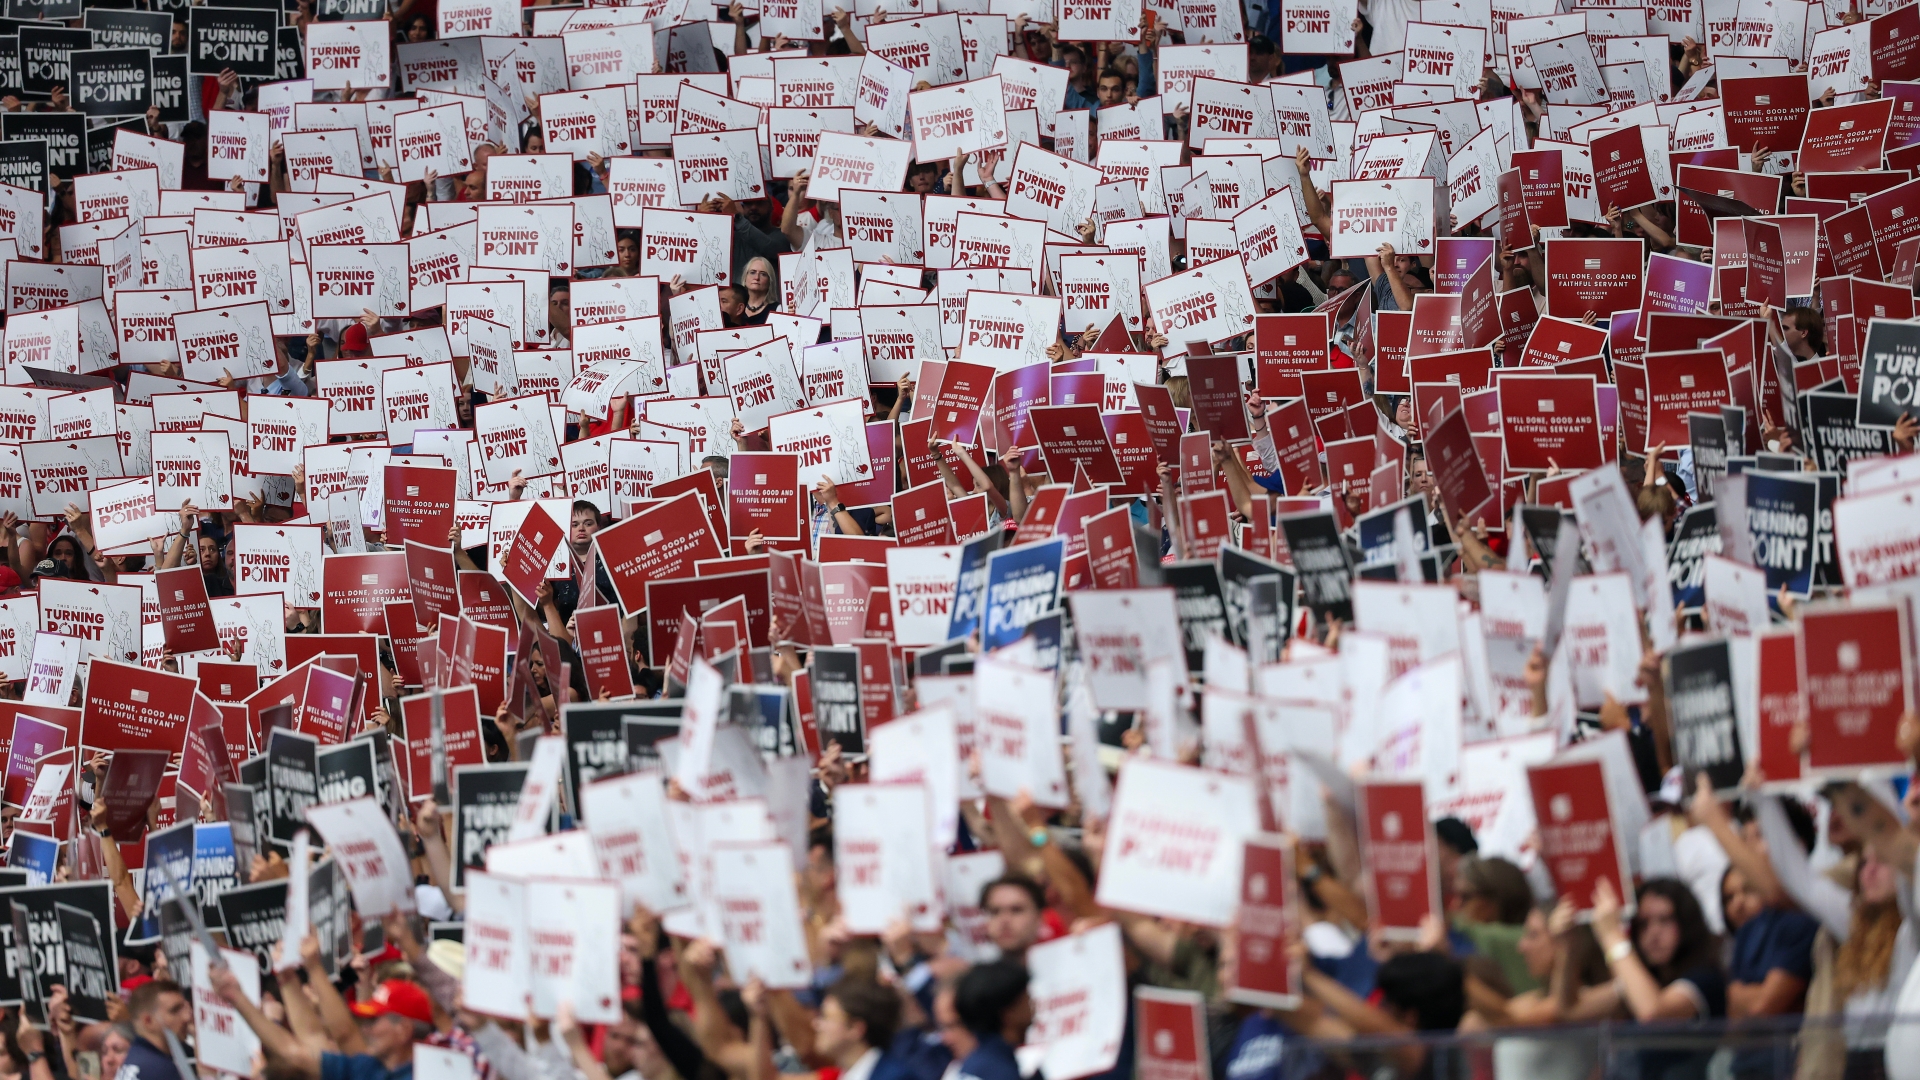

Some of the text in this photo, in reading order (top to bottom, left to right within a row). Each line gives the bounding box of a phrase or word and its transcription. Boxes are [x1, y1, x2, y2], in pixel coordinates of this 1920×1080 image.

[443, 8, 492, 22] TURNING
[763, 5, 797, 18] POINT
[1064, 8, 1111, 20] POINT
[1181, 5, 1216, 15] TURNING
[1286, 10, 1330, 19] TURNING
[1648, 8, 1692, 22] POINT
[444, 18, 492, 33] POINT
[1183, 15, 1216, 28] POINT
[1287, 20, 1330, 33] POINT
[1738, 22, 1773, 32] TURNING
[198, 28, 268, 43] TURNING
[1737, 33, 1772, 47] POINT
[200, 42, 268, 62] POINT
[310, 46, 360, 56] TURNING
[569, 50, 622, 63] TURNING
[1408, 48, 1454, 61] TURNING
[1813, 49, 1850, 65] TURNING
[312, 56, 360, 69] POINT
[404, 59, 458, 72] TURNING
[571, 60, 622, 77] POINT
[1409, 61, 1453, 76] POINT
[1811, 60, 1850, 80] POINT
[77, 69, 145, 84] TURNING
[407, 68, 458, 84] POINT
[1540, 63, 1574, 79] TURNING
[780, 82, 834, 92] TURNING
[862, 75, 889, 98] TURNING
[1544, 74, 1578, 92] POINT
[80, 84, 145, 102] POINT
[782, 93, 834, 107] POINT
[860, 89, 887, 110] POINT
[917, 108, 974, 126] TURNING
[1197, 103, 1253, 120] TURNING
[1277, 110, 1309, 121] TURNING
[546, 115, 596, 128] TURNING
[1200, 115, 1252, 134] POINT
[1280, 121, 1311, 137] POINT
[549, 126, 596, 142] POINT
[921, 119, 974, 140] POINT
[211, 135, 246, 146] TURNING
[399, 133, 440, 147] TURNING
[212, 146, 246, 160] POINT
[402, 143, 442, 162] POINT
[290, 156, 333, 167] TURNING
[679, 158, 728, 168] TURNING
[820, 156, 874, 171] TURNING
[1365, 158, 1403, 167] TURNING
[682, 168, 729, 183] POINT
[818, 167, 873, 184] POINT
[1018, 169, 1066, 195] TURNING
[491, 180, 541, 189] TURNING
[613, 182, 666, 192] TURNING
[80, 196, 129, 210] TURNING
[614, 192, 665, 207] POINT
[1015, 182, 1063, 210] POINT
[1338, 207, 1397, 218] TURNING
[845, 216, 893, 227] TURNING
[1339, 218, 1397, 234] POINT
[482, 231, 538, 241] TURNING
[646, 235, 698, 248] TURNING
[848, 227, 894, 242] POINT
[1240, 225, 1276, 251] TURNING
[484, 242, 538, 255] POINT
[647, 247, 697, 263] POINT
[960, 240, 1010, 255] TURNING
[1243, 236, 1279, 266] POINT
[199, 270, 257, 284] TURNING
[317, 271, 374, 280] TURNING
[12, 286, 68, 297] TURNING
[202, 281, 257, 298] POINT
[319, 282, 374, 296] POINT
[1065, 283, 1109, 294] TURNING
[1068, 295, 1110, 309] POINT
[1156, 292, 1215, 319] TURNING
[575, 304, 626, 316] TURNING
[968, 319, 1024, 334] TURNING
[1162, 304, 1217, 334] POINT
[8, 336, 51, 351] TURNING
[182, 333, 238, 349] TURNING
[867, 334, 913, 344] TURNING
[968, 331, 1023, 349] POINT
[9, 347, 51, 364] POINT
[186, 344, 240, 364] POINT
[577, 348, 630, 362] TURNING
[872, 346, 915, 360] POINT
[732, 373, 772, 394] TURNING
[806, 370, 843, 385] TURNING
[322, 385, 374, 397] TURNING
[736, 384, 776, 411] POINT
[809, 381, 844, 400] POINT
[386, 393, 429, 407] TURNING
[389, 405, 429, 423] POINT
[1526, 417, 1549, 425] DONE,
[53, 418, 91, 434] TURNING
[251, 423, 296, 435] TURNING
[253, 435, 296, 452] POINT
[481, 428, 526, 444] TURNING
[485, 440, 527, 460] POINT
[31, 466, 87, 479] TURNING
[156, 460, 201, 470] TURNING
[568, 463, 608, 482] TURNING
[158, 473, 201, 487] POINT
[613, 468, 654, 480] TURNING
[35, 477, 89, 494] POINT
[1747, 508, 1808, 531] TURNING
[614, 527, 705, 573] WELL DONE, GOOD AND
[239, 554, 290, 565] TURNING
[625, 540, 700, 577] FAITHFUL SERVANT
[241, 566, 290, 582] POINT
[991, 571, 1056, 603] TURNING
[45, 608, 104, 624] TURNING
[988, 593, 1054, 635] POINT
[34, 663, 63, 676] TURNING
[30, 677, 61, 695] POINT
[92, 697, 185, 722] WELL DONE, GOOD AND
[99, 707, 176, 729] FAITHFUL SERVANT
